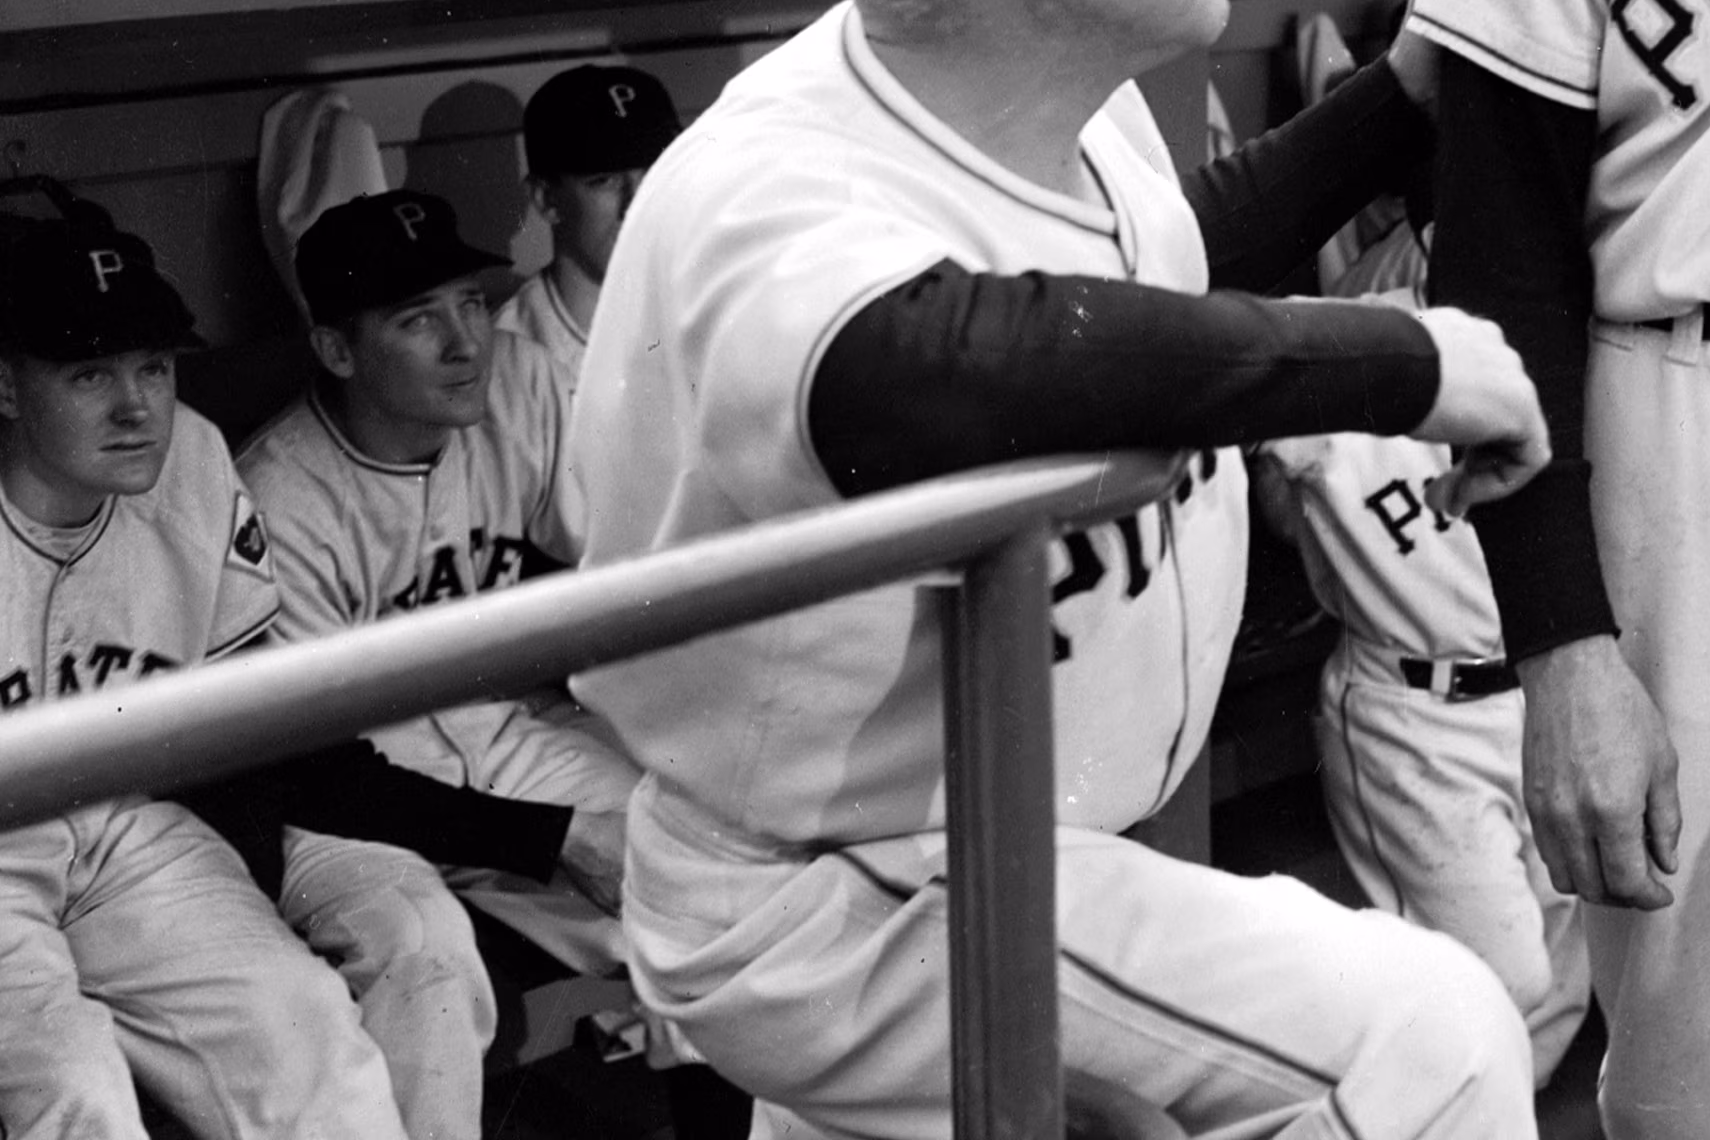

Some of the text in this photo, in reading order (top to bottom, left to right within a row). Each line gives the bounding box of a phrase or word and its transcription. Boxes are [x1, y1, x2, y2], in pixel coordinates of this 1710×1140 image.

[609, 84, 635, 117] P
[394, 202, 426, 239] P
[90, 250, 123, 292] P
